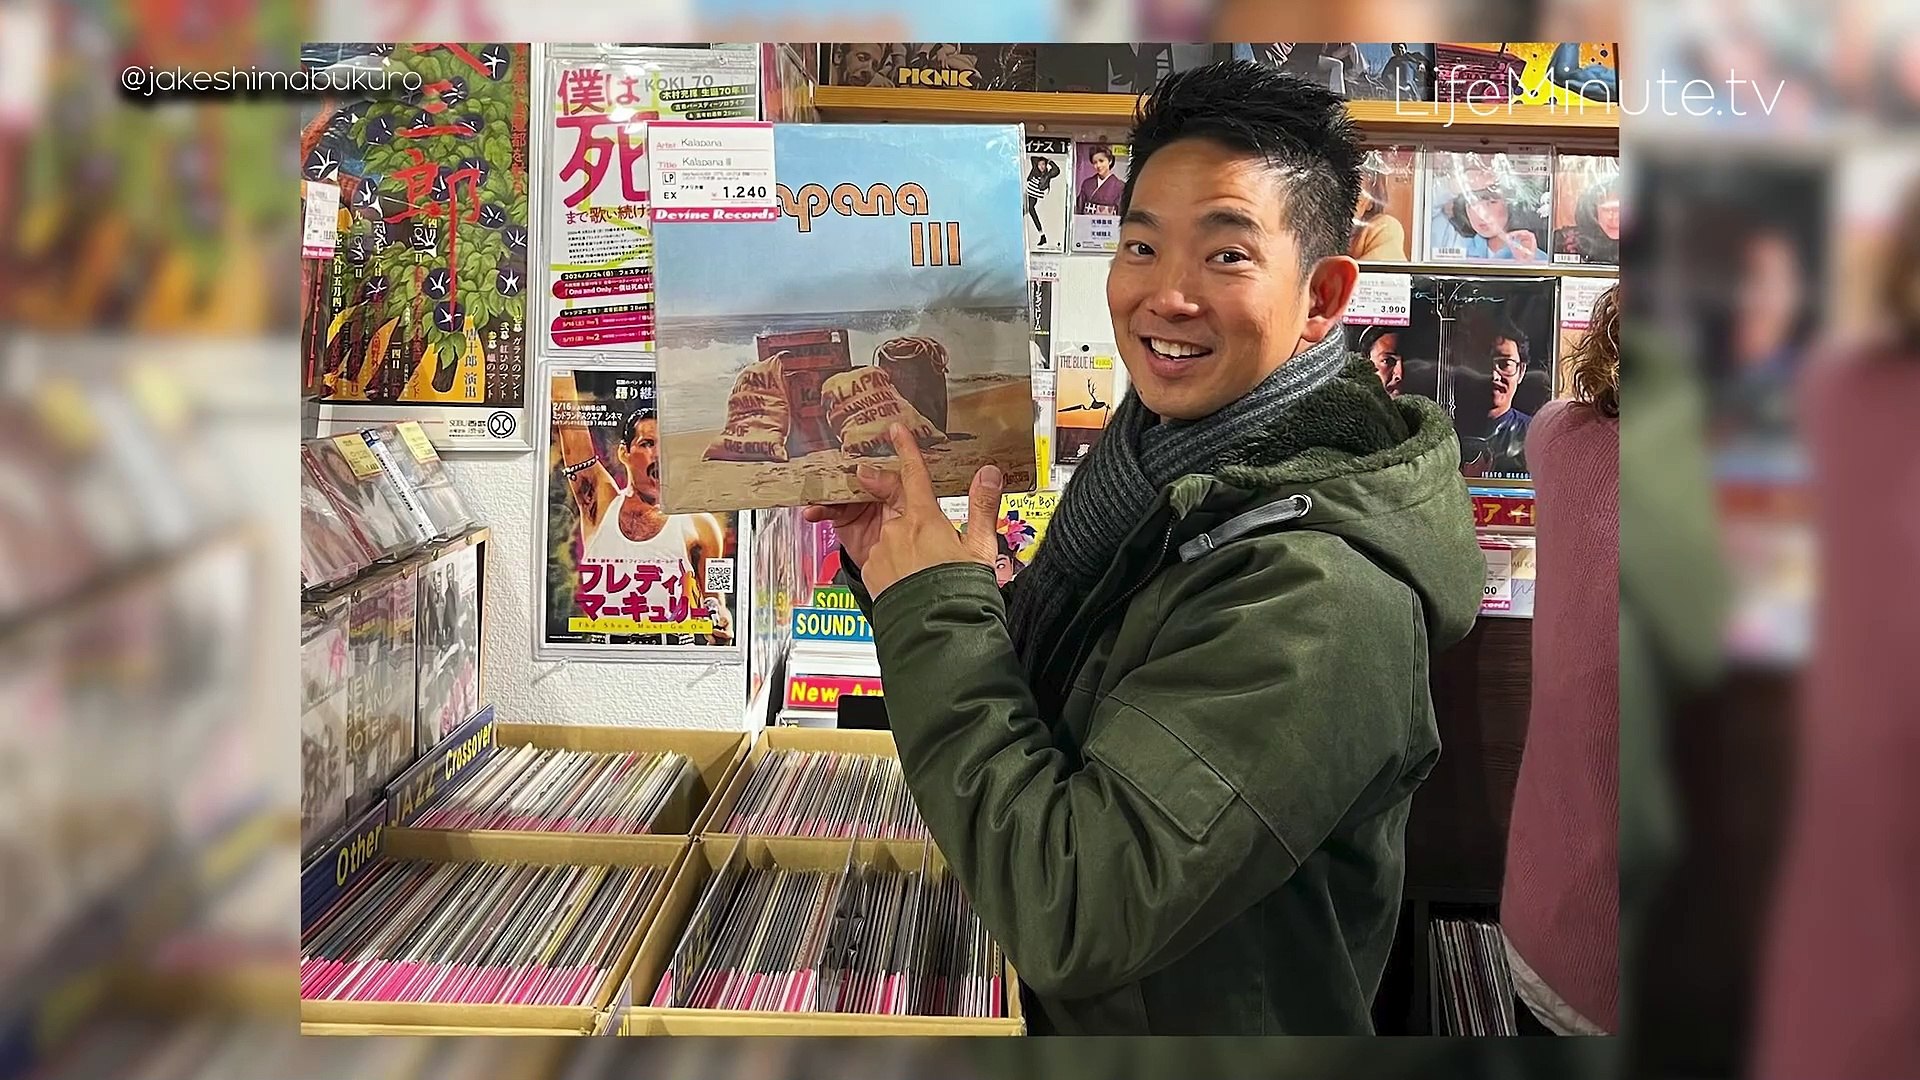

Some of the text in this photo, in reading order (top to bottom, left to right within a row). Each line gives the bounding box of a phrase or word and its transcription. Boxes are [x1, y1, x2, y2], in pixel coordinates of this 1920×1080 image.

[644, 74, 714, 93] KOKI 70
[899, 67, 975, 88] PICNIC
[557, 68, 641, 116] 僕は
[681, 138, 723, 148] Kalapana
[657, 161, 677, 169] Title
[682, 157, 724, 168] Kalapana
[663, 173, 674, 183] LP
[663, 191, 677, 200] EX
[723, 185, 767, 199] 1.240
[565, 204, 650, 226] まで歌い続け
[655, 208, 775, 221] Devine Records
[1380, 305, 1406, 314] 3.990
[854, 401, 901, 426] EXPORT
[1004, 494, 1056, 510] TOUGH BOY
[577, 563, 679, 596] フレディ
[576, 591, 709, 624] マーキュリー
[603, 621, 630, 630] Show
[790, 681, 839, 704] New
[444, 720, 493, 781] Crossover
[335, 823, 383, 887] Other
